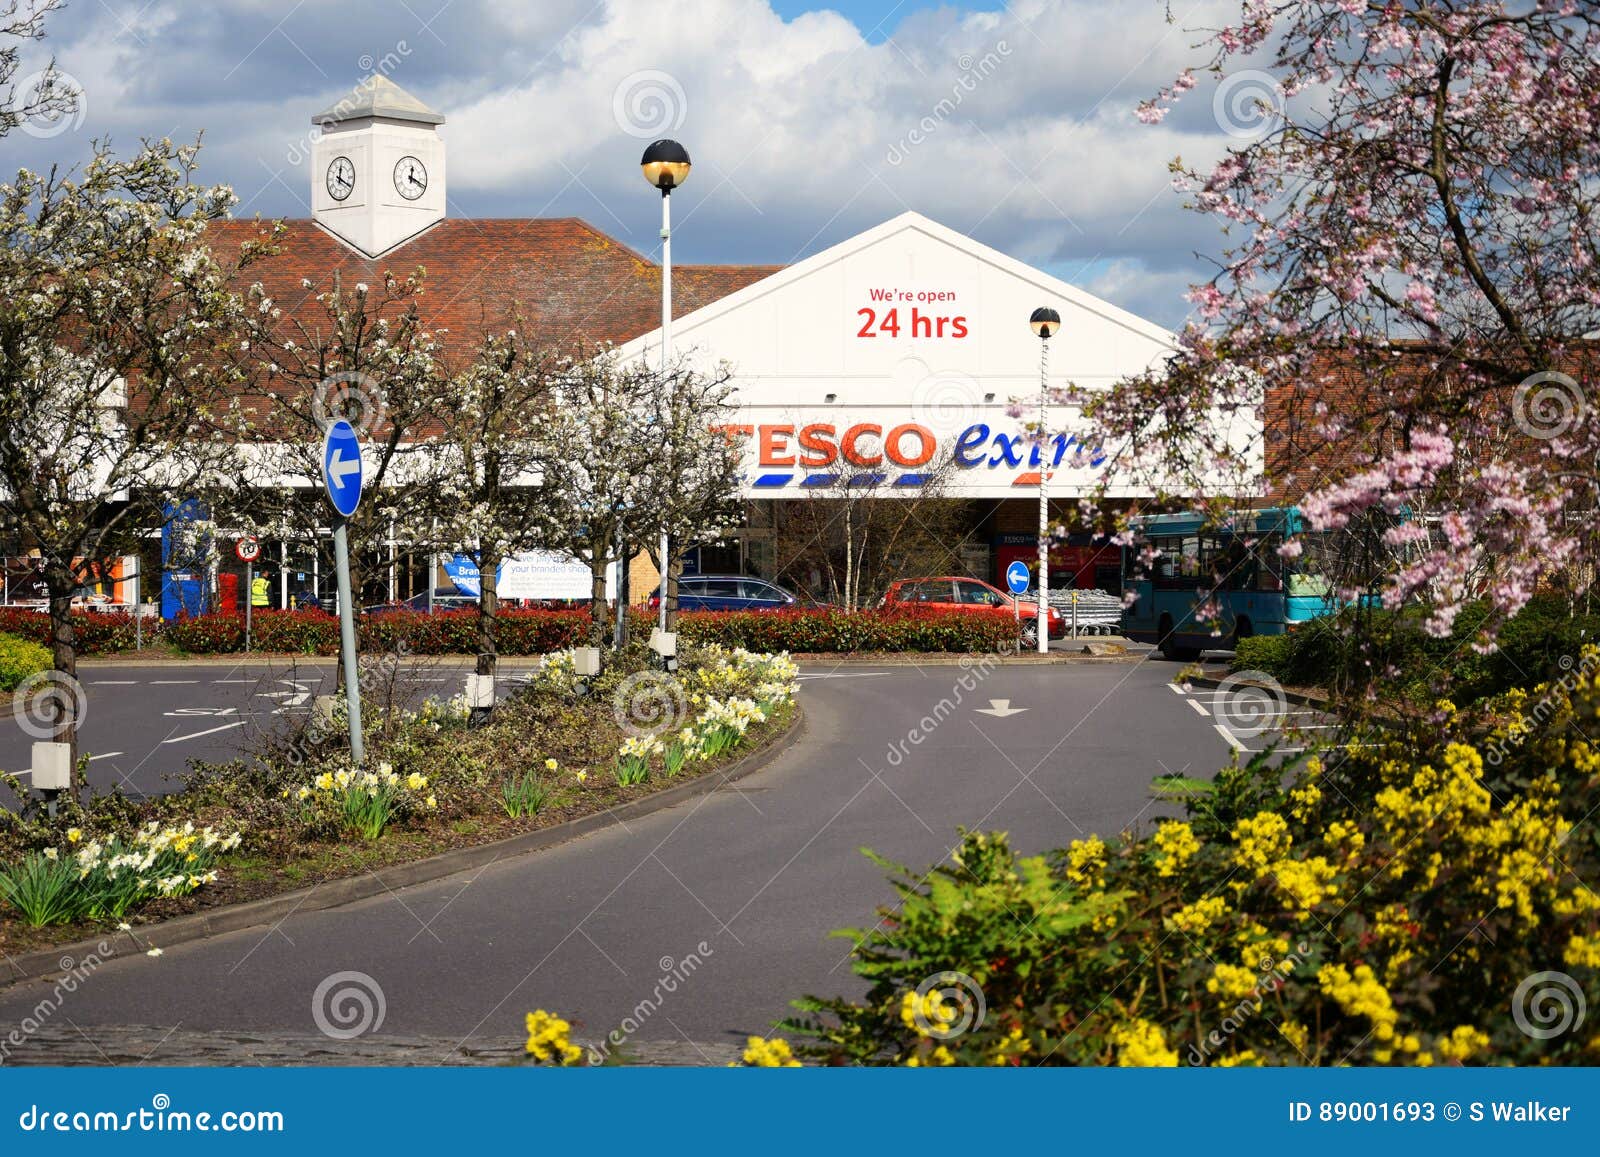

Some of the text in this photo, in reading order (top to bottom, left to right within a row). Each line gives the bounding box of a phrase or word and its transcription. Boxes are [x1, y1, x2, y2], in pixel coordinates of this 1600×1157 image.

[917, 291, 956, 304] open
[857, 307, 968, 338] 24 hrs
[708, 423, 937, 467] TESCO
[458, 566, 480, 575] Bran
[511, 565, 529, 574] your
[531, 564, 566, 573] branded
